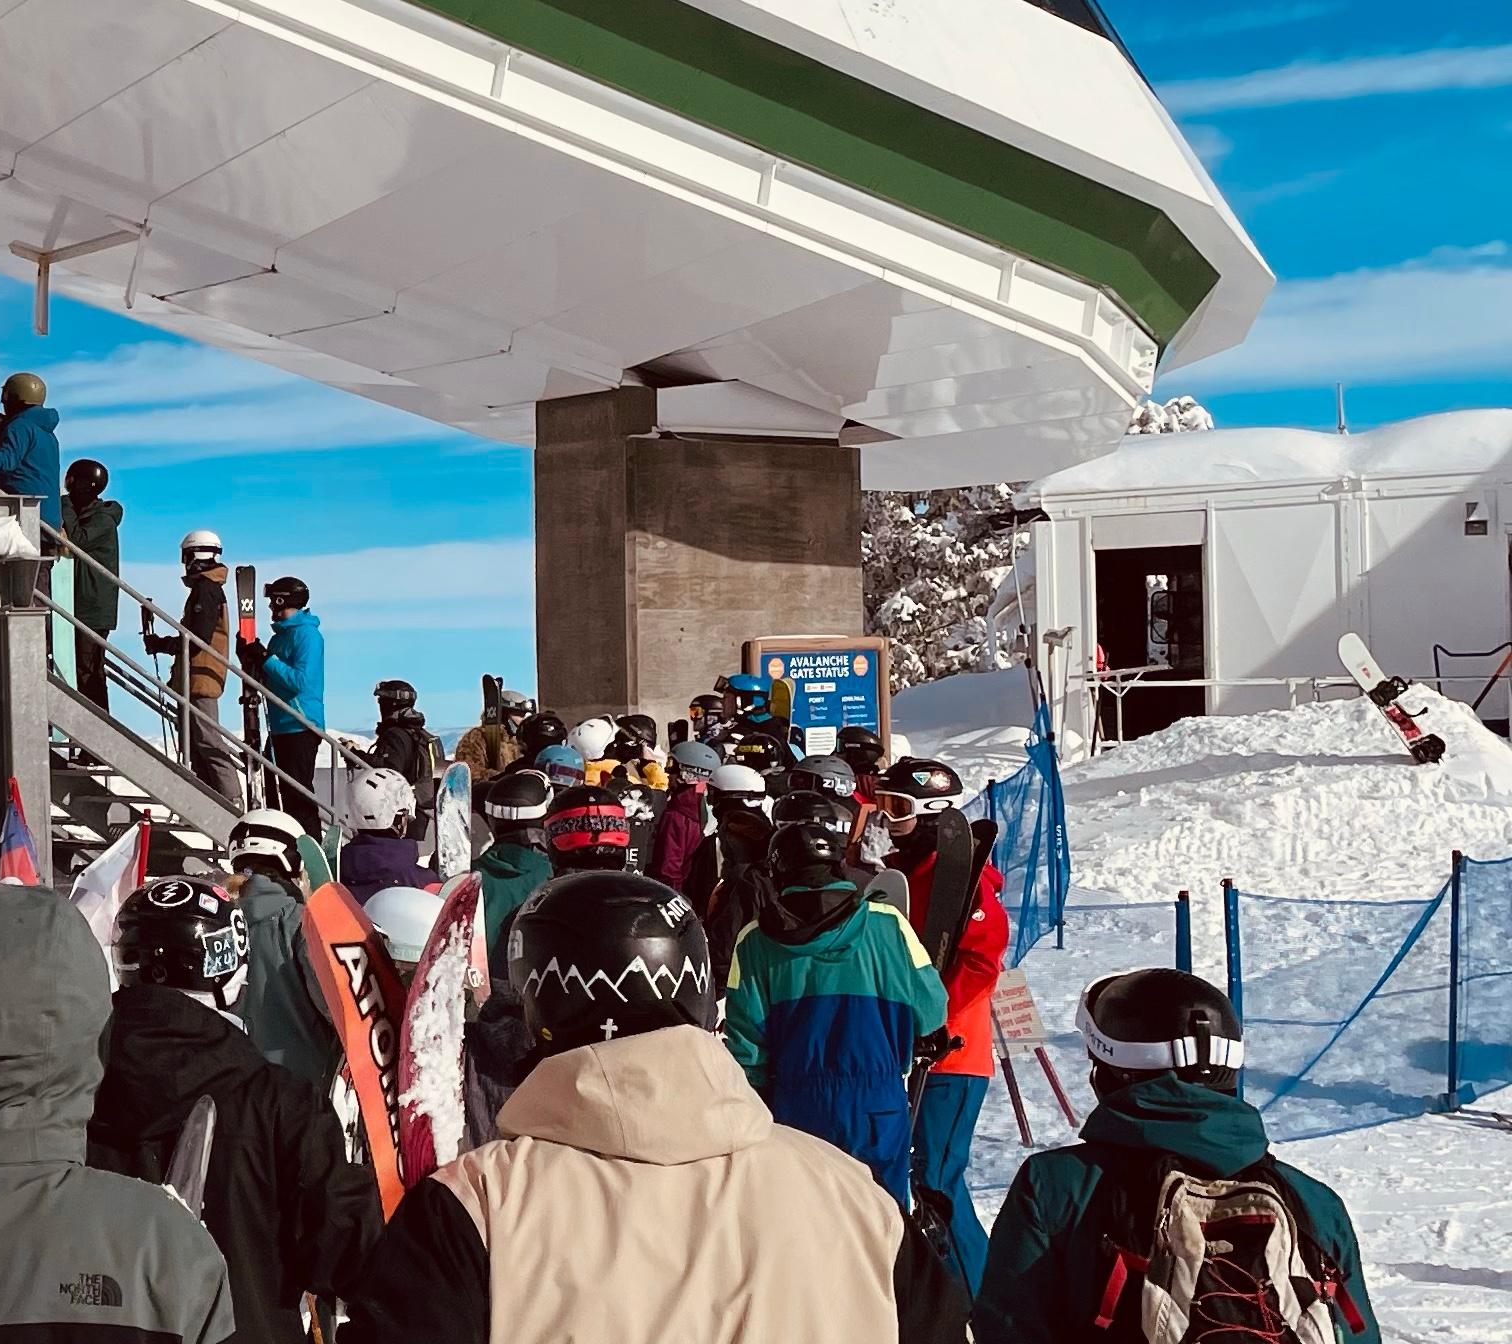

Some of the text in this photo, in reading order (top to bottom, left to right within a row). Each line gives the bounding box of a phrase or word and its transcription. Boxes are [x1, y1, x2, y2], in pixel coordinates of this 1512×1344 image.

[790, 656, 849, 667] AVALANCHE
[790, 668, 814, 679] GATE
[816, 666, 849, 678] STATUS
[79, 1272, 101, 1285] THE
[59, 1283, 101, 1296] NORTH
[70, 1294, 101, 1306] FACE
